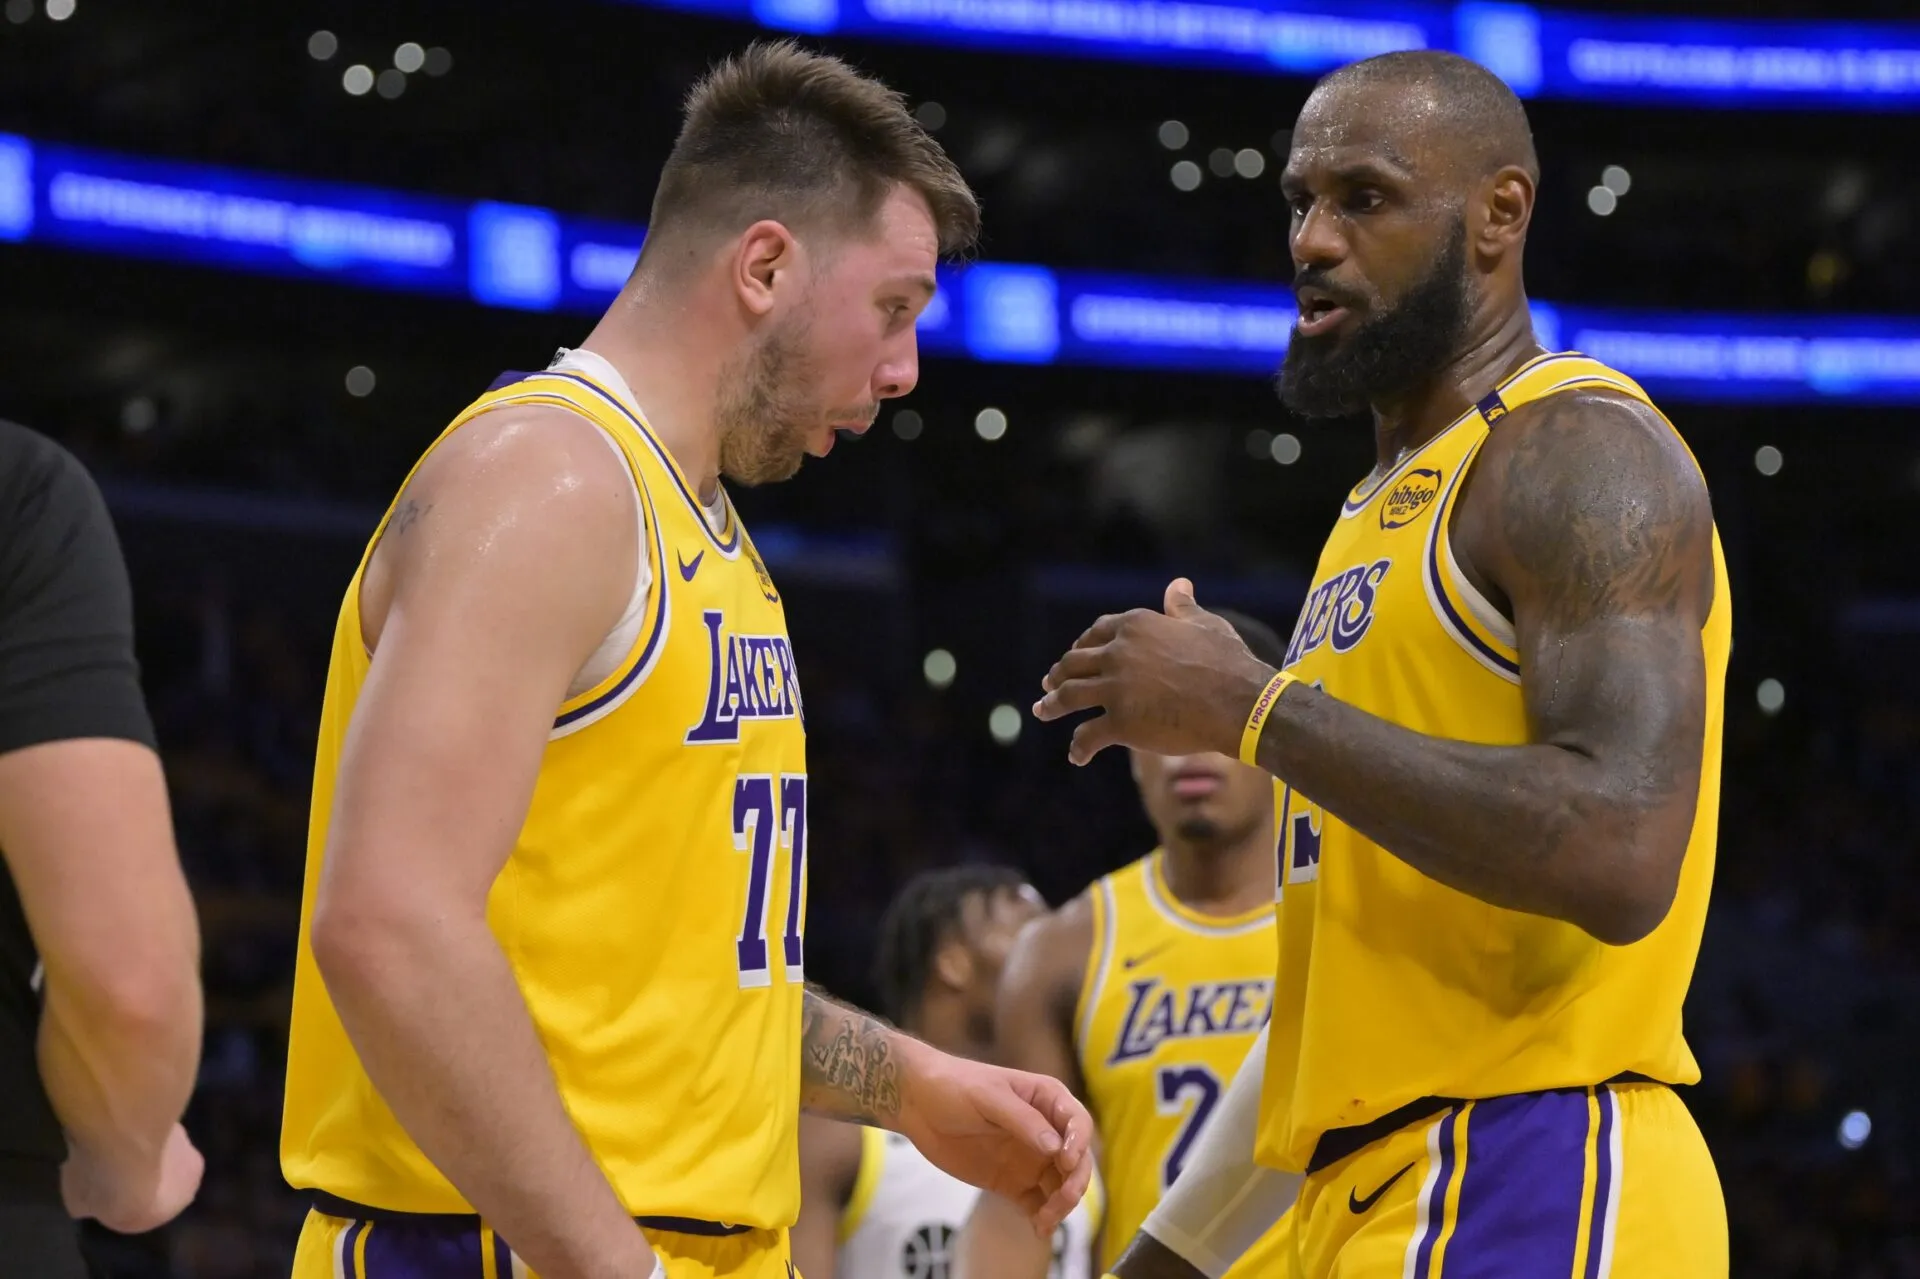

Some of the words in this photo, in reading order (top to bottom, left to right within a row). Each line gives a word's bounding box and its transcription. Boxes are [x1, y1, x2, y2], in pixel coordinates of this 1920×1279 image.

[1388, 485, 1434, 510] bibigo
[682, 608, 806, 746] LAKER
[1251, 675, 1285, 725] PROMISE
[1248, 724, 1258, 732] I
[732, 772, 808, 989] 77
